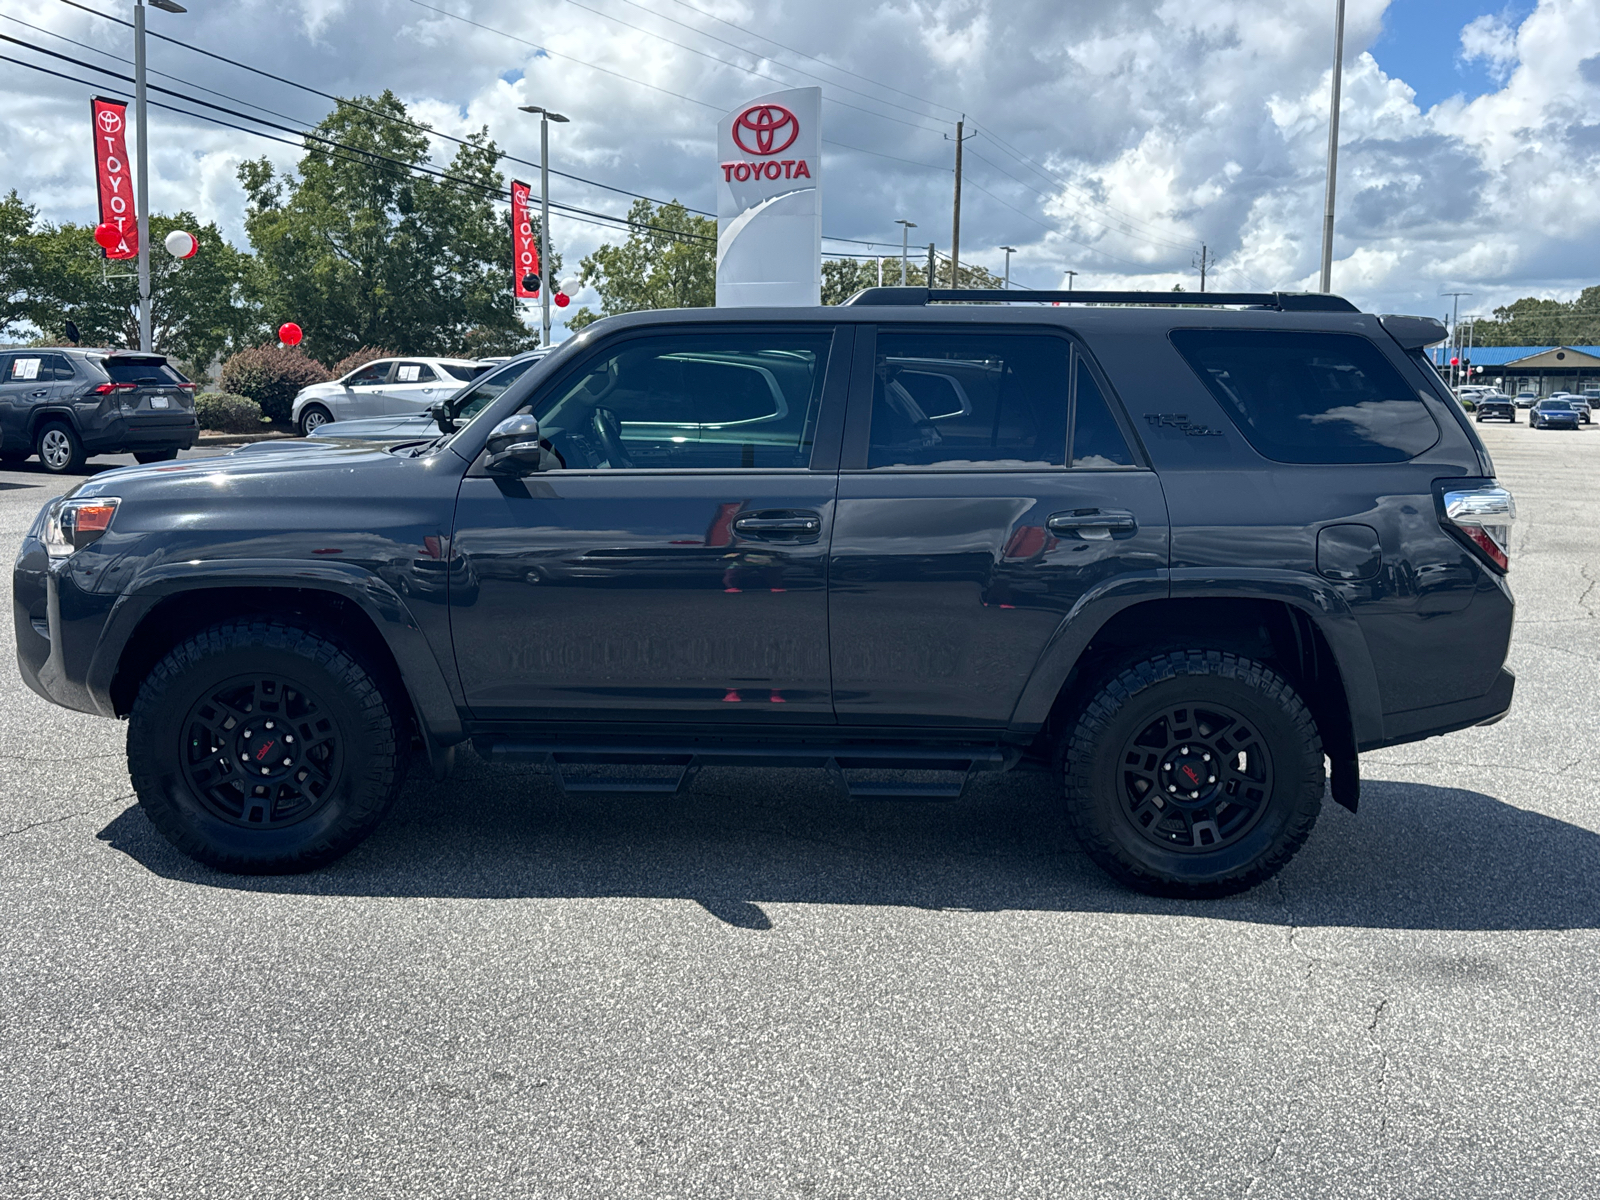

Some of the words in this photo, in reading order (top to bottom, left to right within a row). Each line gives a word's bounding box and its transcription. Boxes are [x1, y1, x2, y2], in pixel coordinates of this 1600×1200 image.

[721, 160, 811, 183] TOYOTA
[104, 136, 130, 253] TOYOTA
[520, 208, 533, 292] TOYOT
[1143, 413, 1189, 427] TRD
[256, 740, 275, 760] TRD
[1182, 765, 1199, 785] TRD
